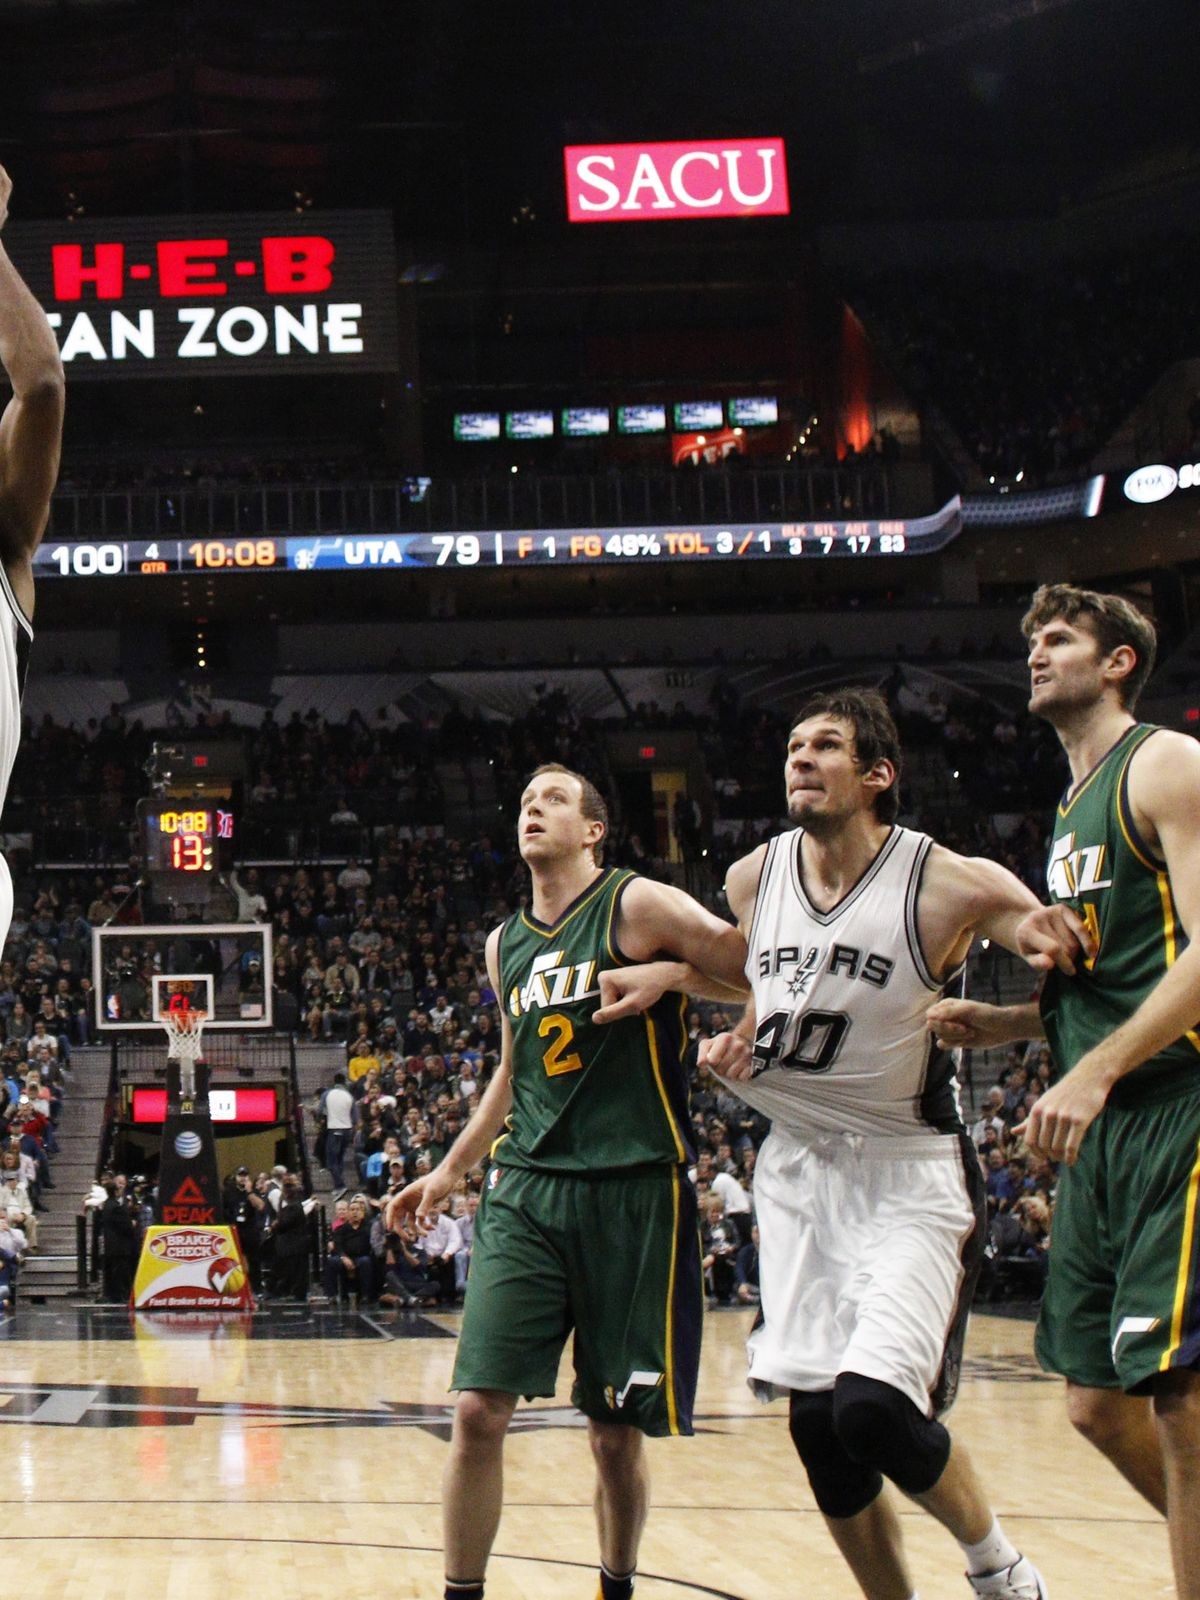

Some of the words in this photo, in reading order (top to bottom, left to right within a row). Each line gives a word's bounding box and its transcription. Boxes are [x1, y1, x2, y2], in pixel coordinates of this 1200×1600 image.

[576, 148, 776, 212] SACU
[52, 236, 335, 300] H-E-B
[178, 303, 363, 357] ZONE
[51, 544, 122, 575] 100
[145, 543, 159, 559] 4
[188, 540, 276, 567] 10:08
[343, 540, 404, 565] UTA
[432, 535, 481, 565] 79
[518, 536, 533, 558] F
[542, 535, 556, 557] 1
[570, 534, 602, 557] FG
[605, 533, 661, 556] 48%
[664, 531, 710, 555] TOL
[789, 538, 802, 555] 3
[820, 536, 834, 554] 7
[847, 535, 871, 553] 17
[160, 811, 207, 833] 10:08
[172, 835, 203, 870] 13
[510, 950, 601, 1017] JAZZ
[538, 1013, 583, 1077] 2
[751, 1008, 852, 1079] 40
[162, 1206, 216, 1224] PEAK
[166, 1235, 213, 1246] BRAKE
[166, 1246, 213, 1257] CHECK
